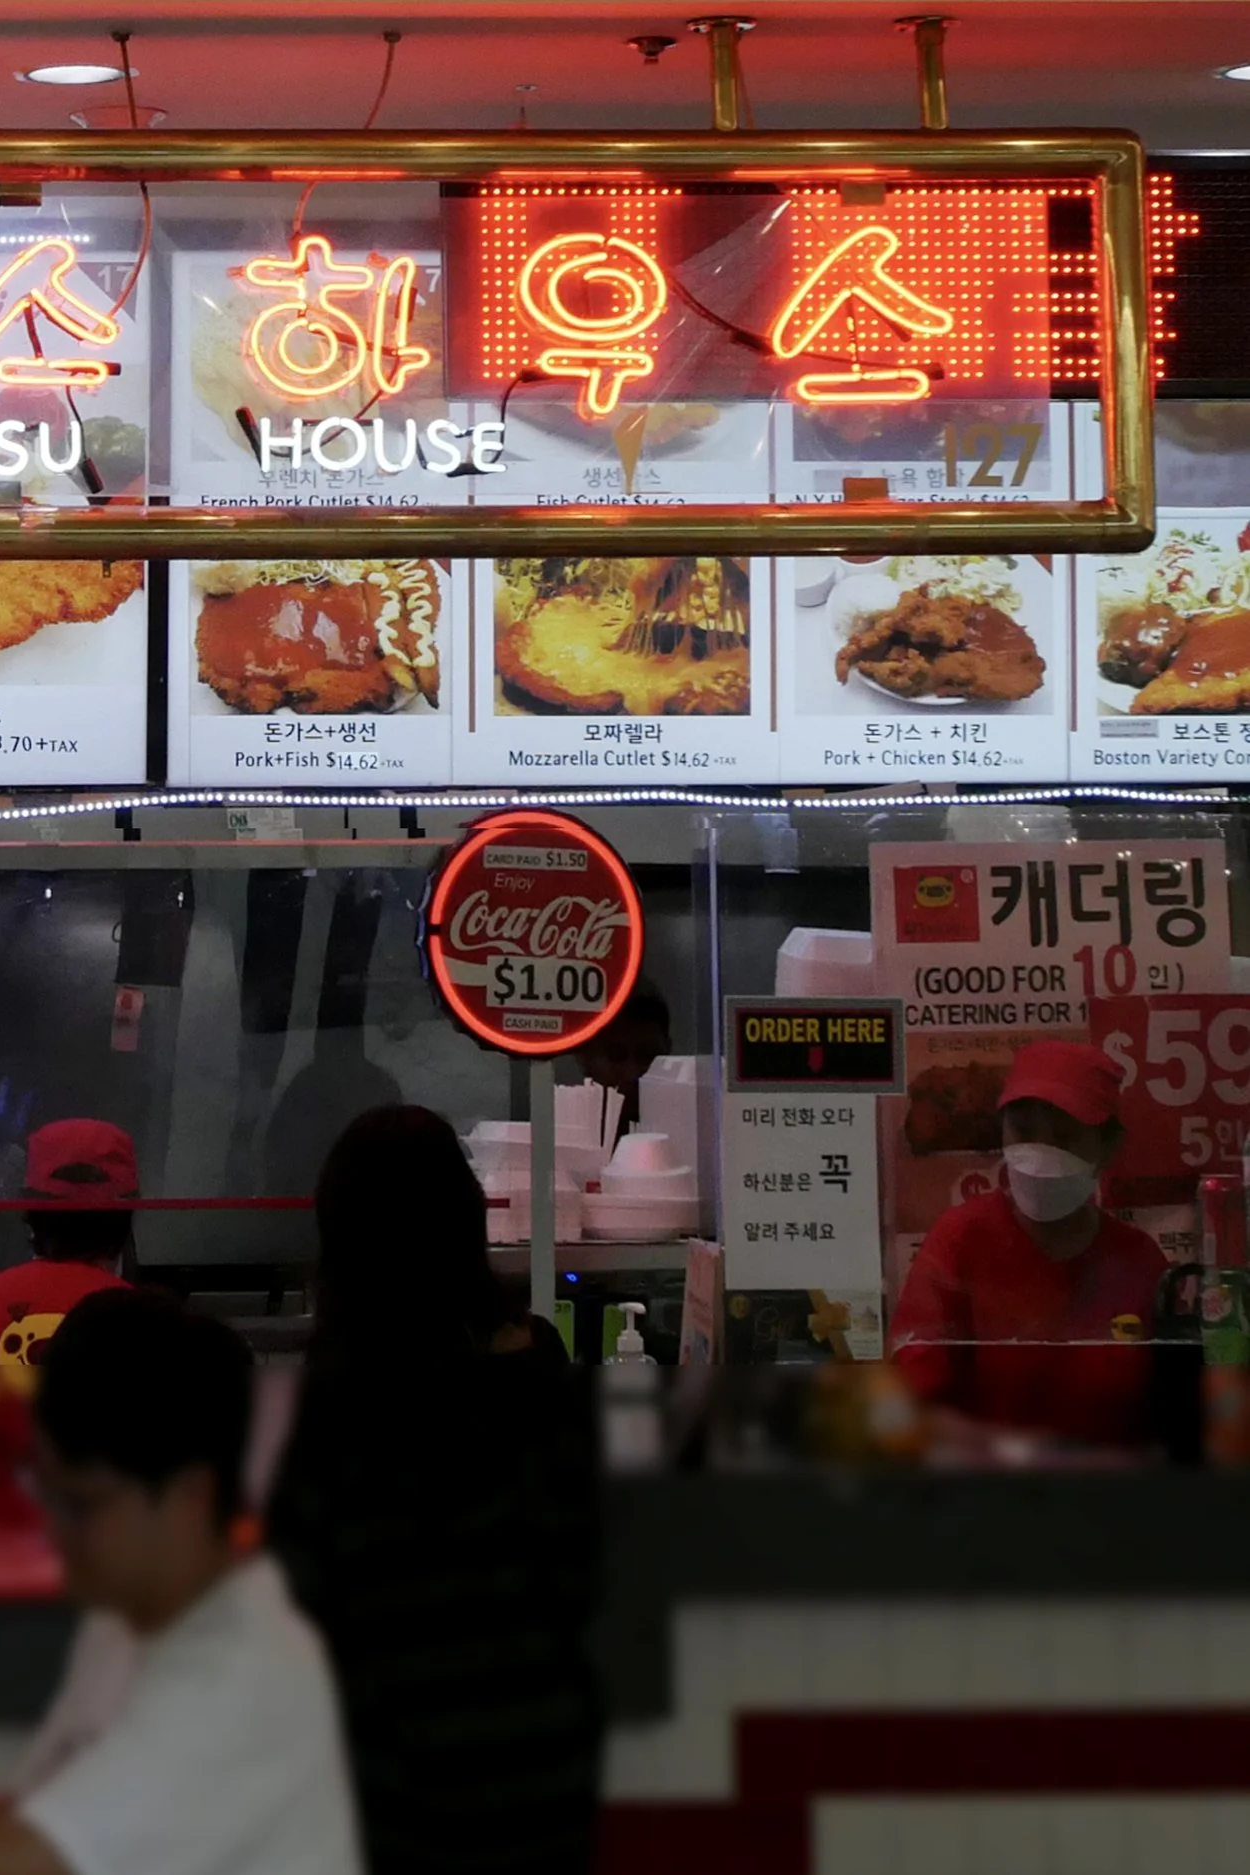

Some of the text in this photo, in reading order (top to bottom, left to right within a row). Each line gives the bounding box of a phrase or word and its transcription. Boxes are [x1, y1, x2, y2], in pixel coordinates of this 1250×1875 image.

[97, 265, 134, 292] 17
[245, 235, 954, 415] 하우스
[258, 416, 508, 474] HOUSE
[943, 422, 1045, 488] 127
[583, 723, 663, 744] 모짜렐라
[863, 722, 923, 743] 돈가스
[950, 722, 988, 743] 치킨
[1172, 722, 1231, 744] 보스톤
[508, 750, 598, 766] Mozzarella
[604, 750, 655, 767] Cutlet
[824, 750, 860, 766] Pork
[881, 750, 946, 766] Chicken
[1093, 749, 1150, 765] Boston
[1157, 750, 1219, 767] Variety
[546, 852, 587, 867] $1.50
[494, 873, 536, 893] Enjoy
[989, 858, 1207, 948] 캐더링
[493, 958, 605, 1005] $1.00
[914, 966, 1005, 998] (GOOD
[1012, 966, 1066, 994] FOR
[1072, 944, 1137, 998] 10
[905, 1004, 1017, 1025] CATERING
[1023, 1003, 1071, 1024] FOR
[744, 1018, 886, 1044] ORDER HERE
[742, 1108, 775, 1126] 미리
[781, 1108, 816, 1126] 전화
[743, 1154, 852, 1193] 하신분은 꼭
[744, 1222, 836, 1241] 알려 주세요
